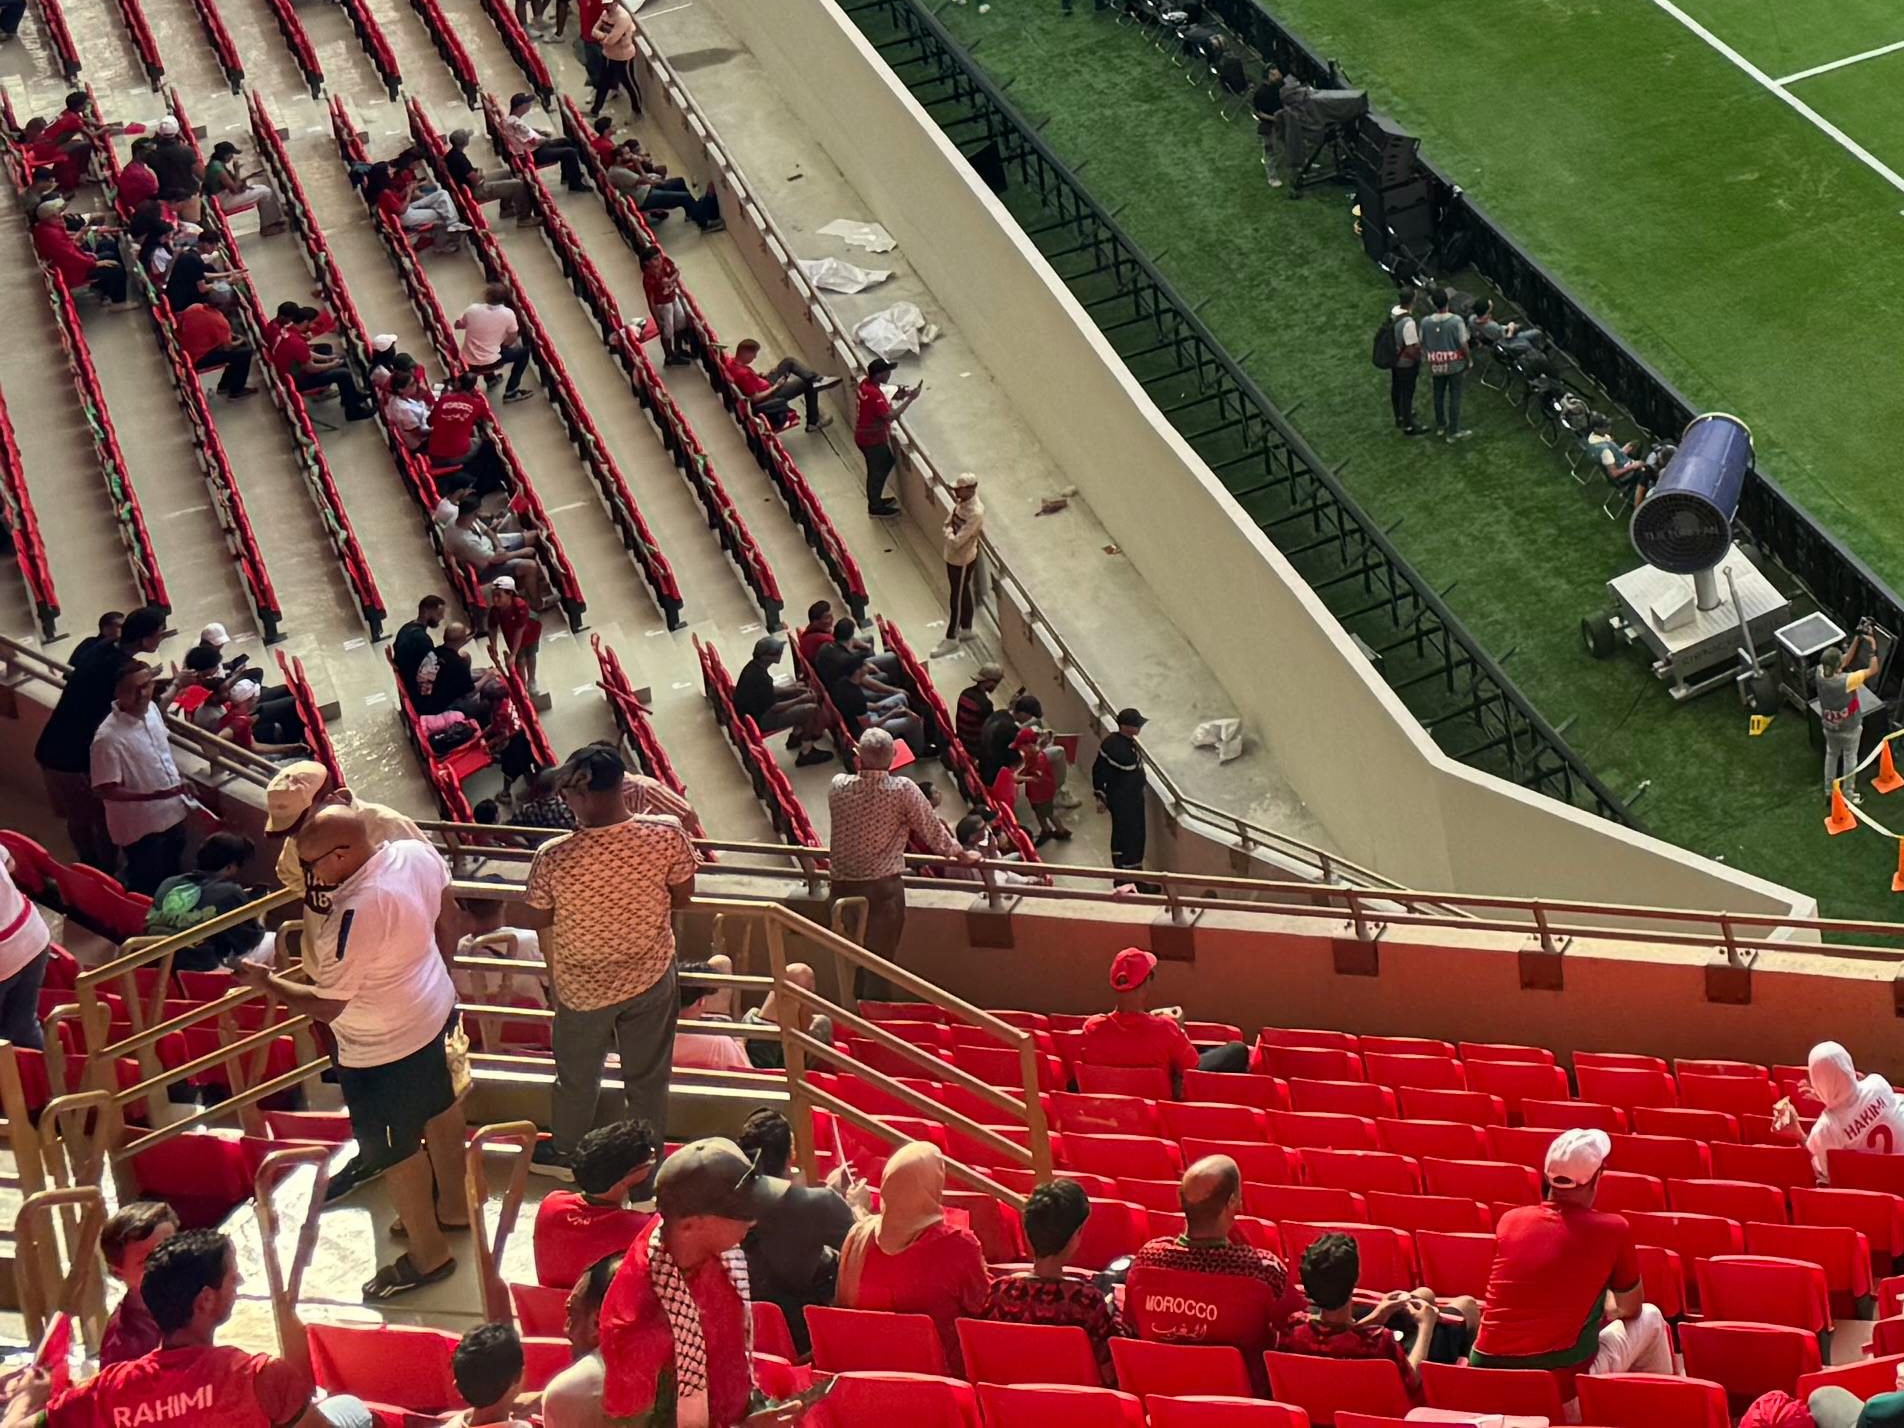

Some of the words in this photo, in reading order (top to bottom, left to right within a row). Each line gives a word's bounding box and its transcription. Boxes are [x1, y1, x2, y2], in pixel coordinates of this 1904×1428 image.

[1843, 1096, 1889, 1141] HAKIMI
[1145, 1295, 1218, 1321] MOROCCO
[113, 1384, 214, 1428] RAHIMI
